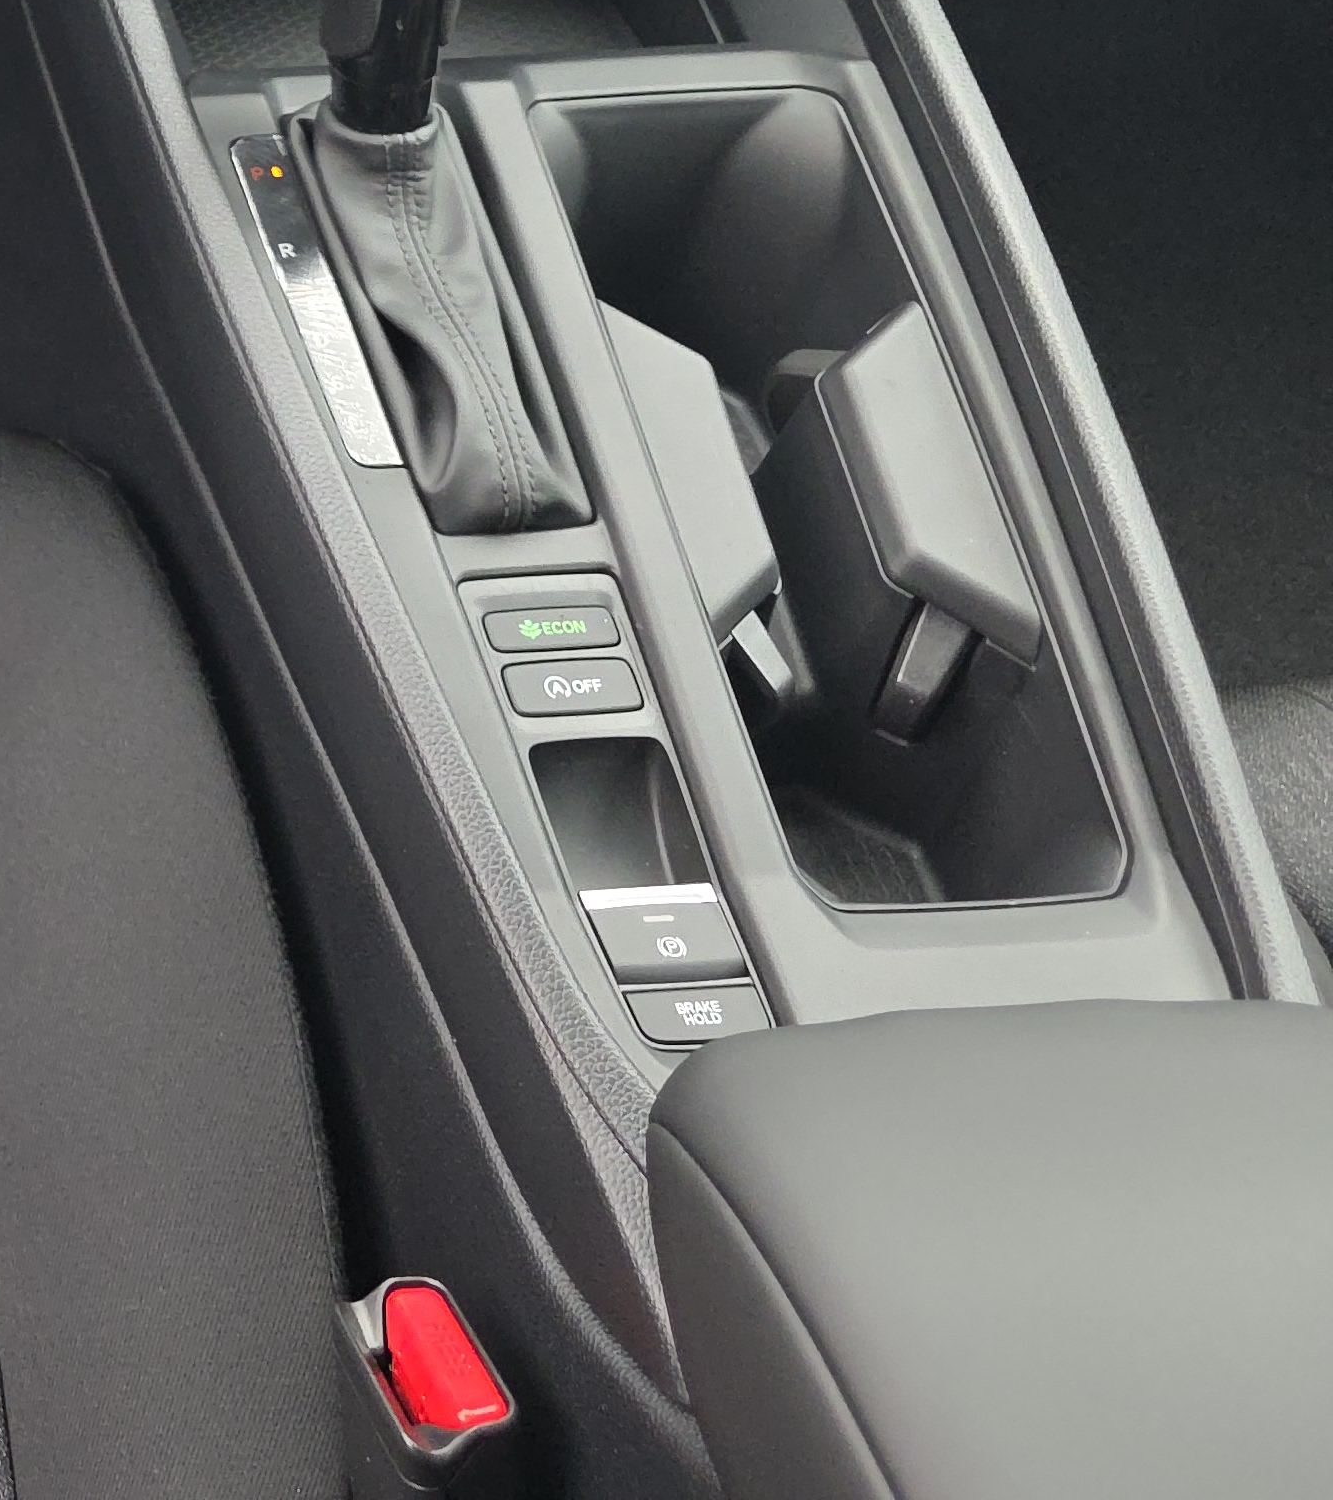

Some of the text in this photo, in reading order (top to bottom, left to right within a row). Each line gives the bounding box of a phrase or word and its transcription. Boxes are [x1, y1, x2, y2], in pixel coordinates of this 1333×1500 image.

[250, 165, 265, 181] P
[278, 242, 297, 258] R
[541, 619, 587, 635] ECON
[571, 677, 602, 694] OFF
[674, 1000, 723, 1015] BRAKE
[682, 1011, 724, 1026] HOLD
